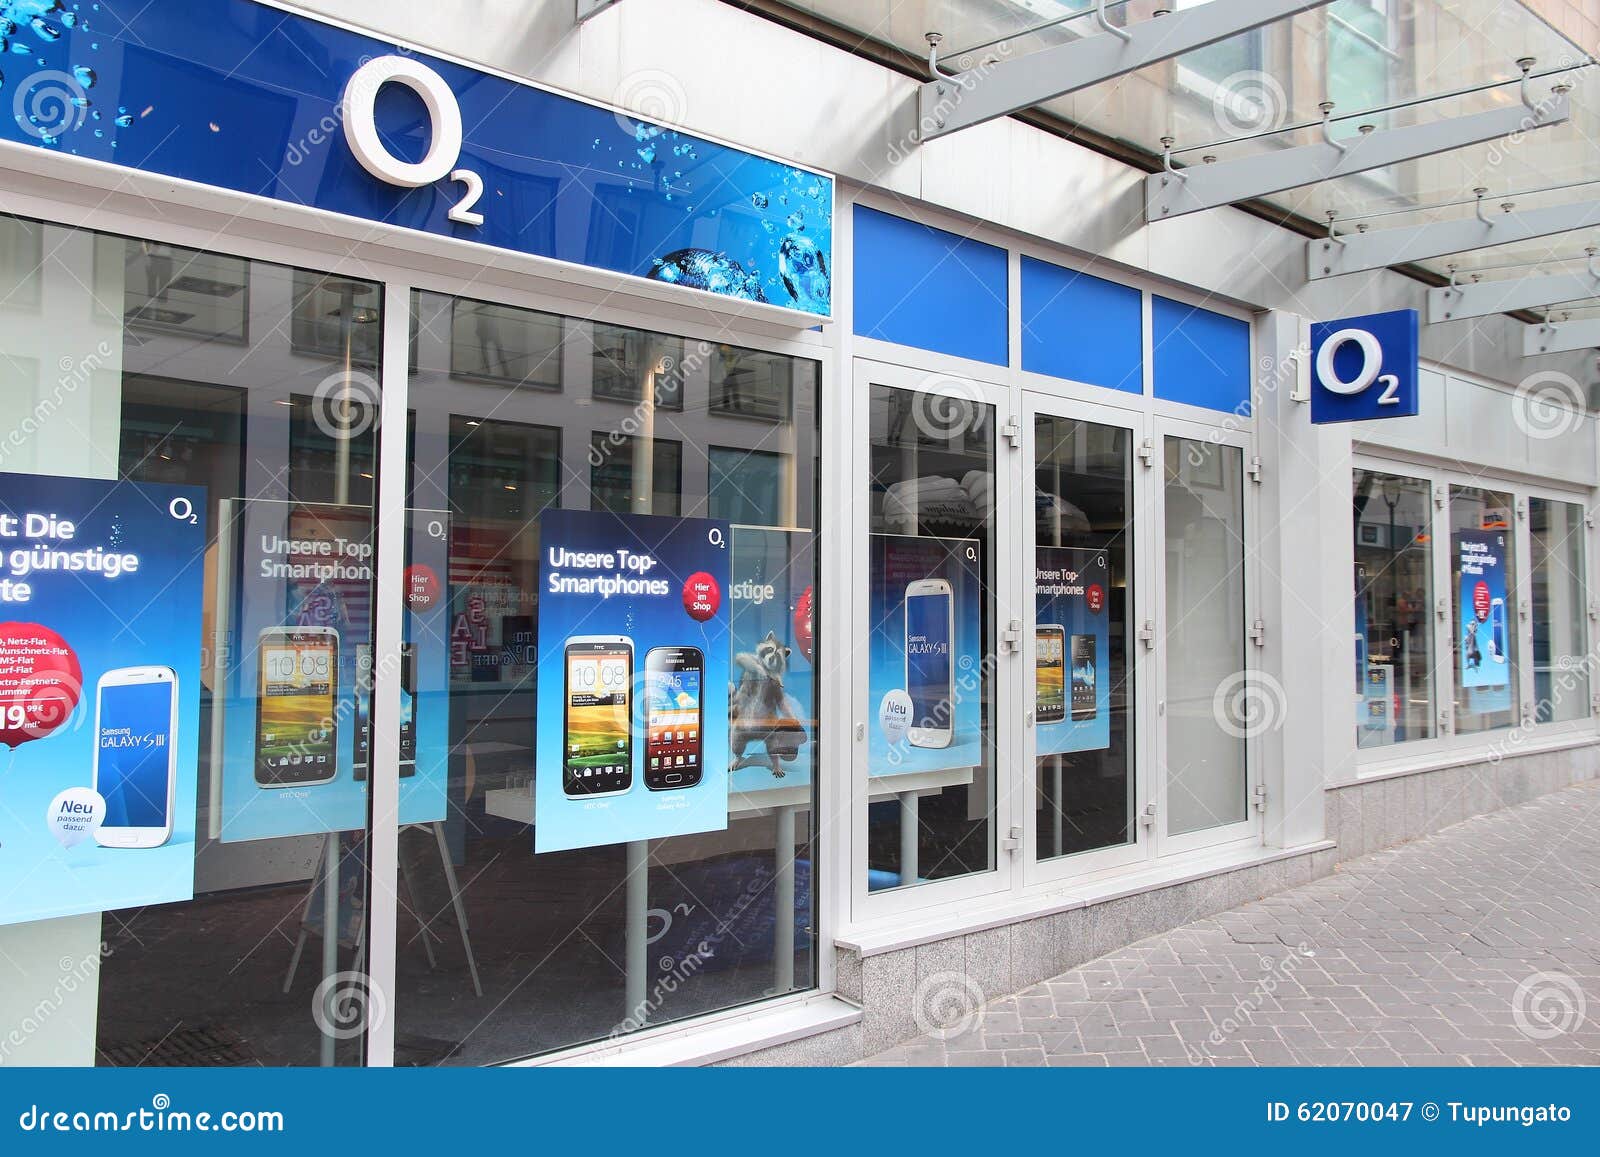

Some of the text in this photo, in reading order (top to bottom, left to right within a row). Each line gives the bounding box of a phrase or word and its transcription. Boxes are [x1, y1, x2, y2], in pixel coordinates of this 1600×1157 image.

[25, 513, 75, 540] Die
[261, 535, 331, 555] Unsere
[9, 544, 139, 577] günstige
[549, 547, 657, 571] Unsere Top-
[260, 558, 371, 583] Smartphon
[411, 575, 429, 584] Hier
[414, 585, 425, 593] im
[549, 573, 669, 598] Smartphones
[694, 583, 711, 592] Hier
[408, 594, 430, 604] Shop
[697, 593, 707, 601] im
[692, 602, 712, 612] Shop
[8, 637, 47, 645] Netz-Flat
[908, 635, 926, 643] Samsung
[908, 643, 933, 654] GALAXY
[887, 701, 906, 714] Neu
[101, 727, 130, 737] Samsung
[101, 735, 141, 748] GALAXY
[60, 800, 93, 814] Neu
[57, 815, 92, 823] passend
